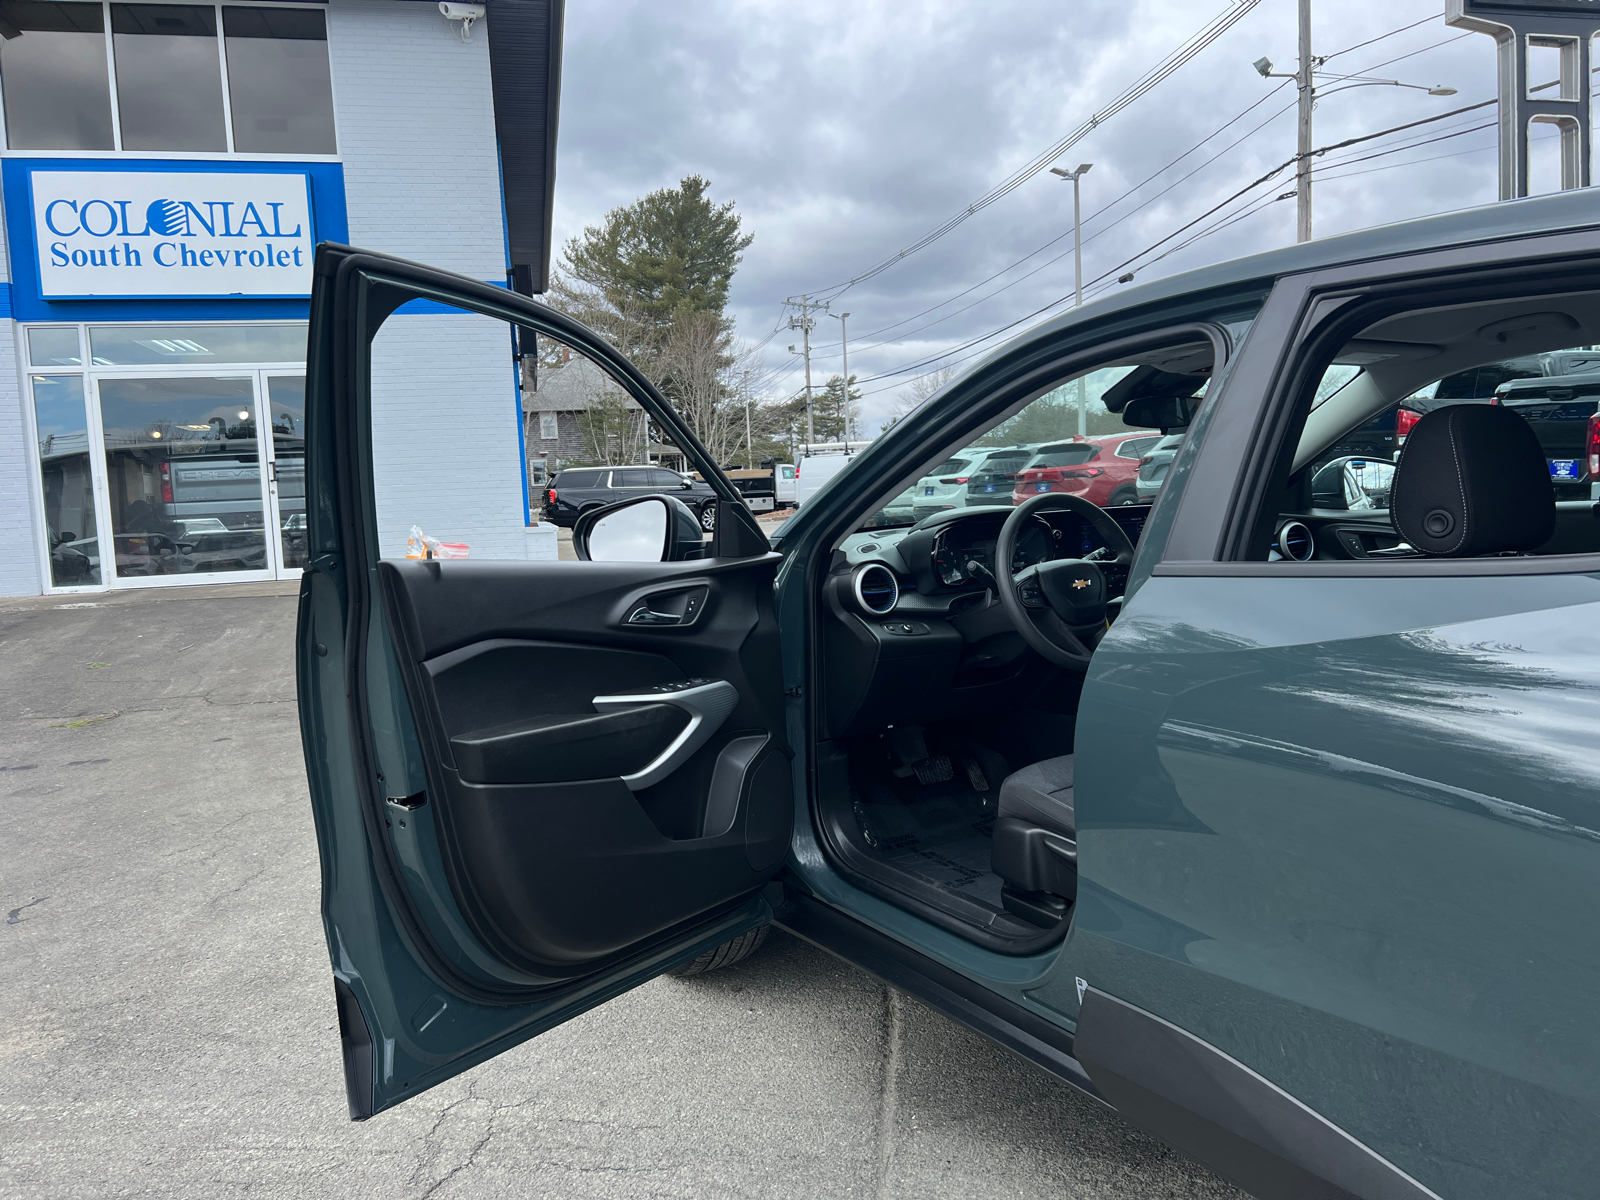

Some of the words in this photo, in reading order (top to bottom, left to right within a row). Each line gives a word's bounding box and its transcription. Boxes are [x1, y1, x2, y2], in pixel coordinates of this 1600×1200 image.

[45, 199, 302, 238] COLONIAL
[51, 242, 142, 267] South
[152, 242, 304, 268] Chevrolet
